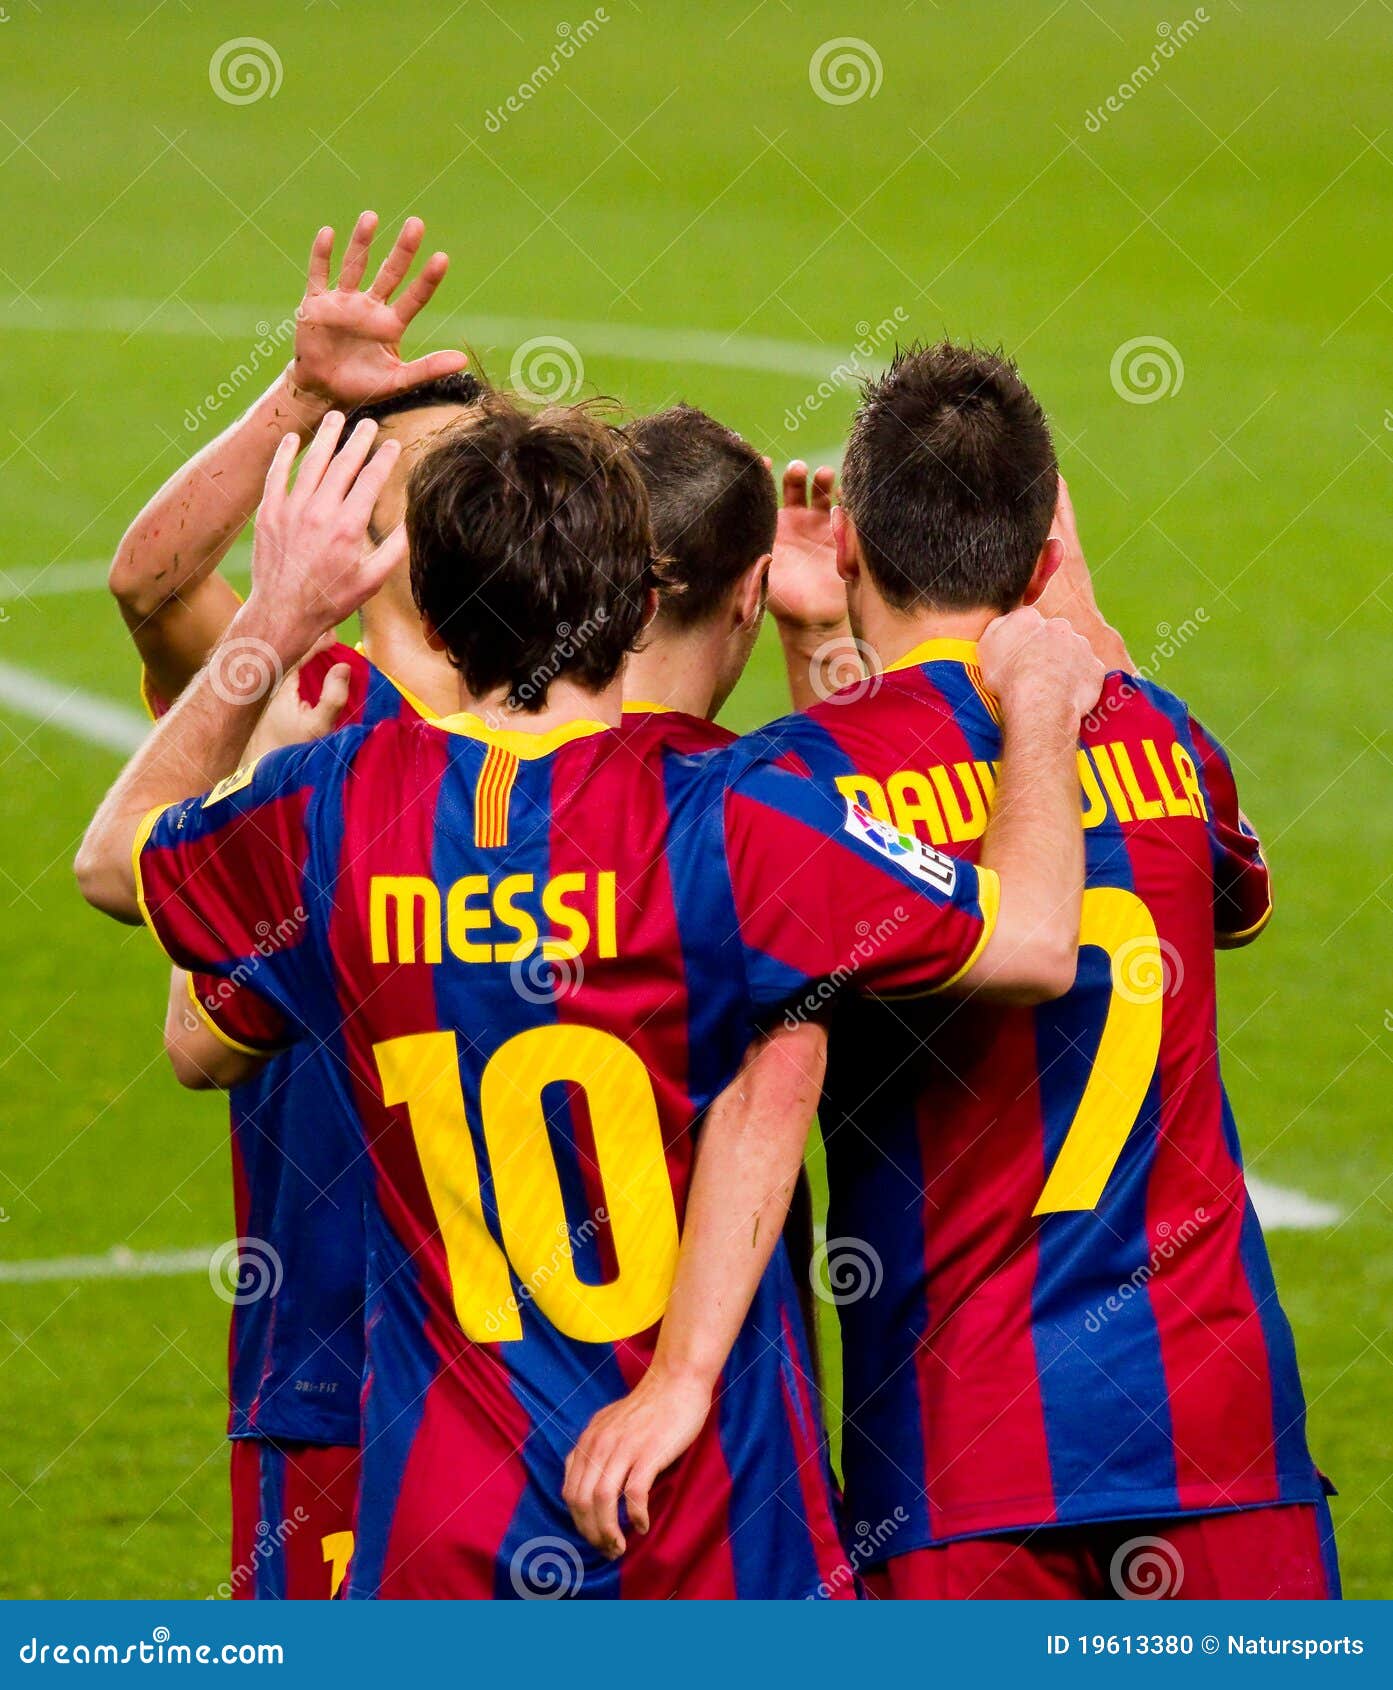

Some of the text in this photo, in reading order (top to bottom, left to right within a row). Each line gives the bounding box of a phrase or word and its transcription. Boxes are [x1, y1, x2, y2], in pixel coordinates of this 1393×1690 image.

[834, 760, 1001, 845] DAVI
[370, 871, 618, 964] MESSI
[372, 1023, 680, 1343] 10
